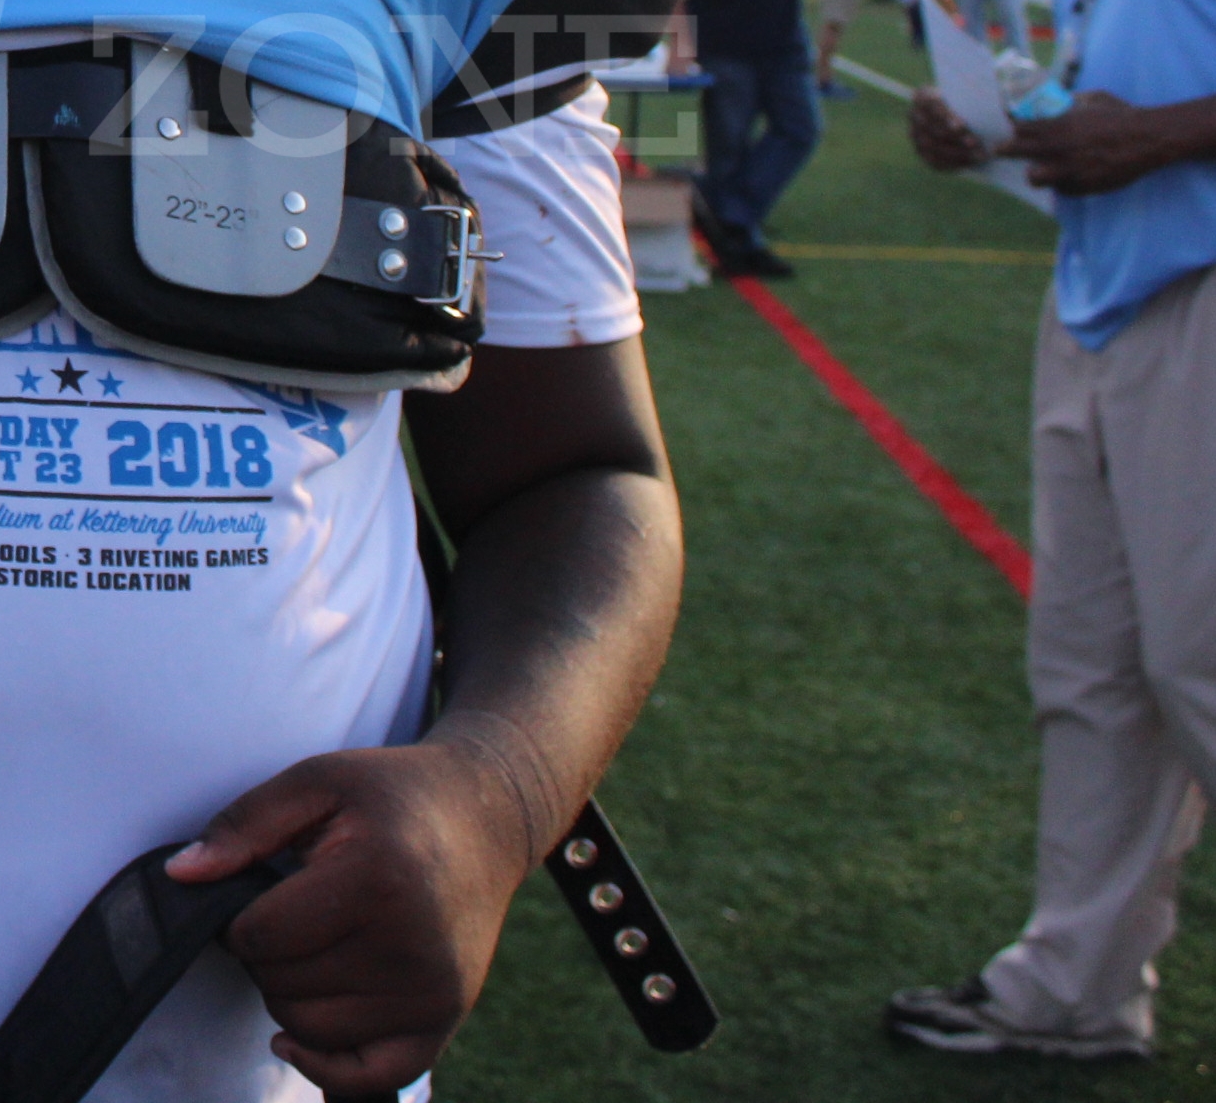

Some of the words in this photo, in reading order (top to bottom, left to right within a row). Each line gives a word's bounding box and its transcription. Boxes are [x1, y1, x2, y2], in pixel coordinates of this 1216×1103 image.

[35, 452, 83, 485] 23
[107, 420, 274, 488] 2018
[48, 508, 76, 531] at
[77, 507, 175, 546] Kettering
[178, 509, 269, 545] University
[78, 547, 92, 566] 3
[100, 548, 200, 568] RIVETING
[206, 547, 269, 568] GAMES
[86, 571, 191, 591] LOCATION
